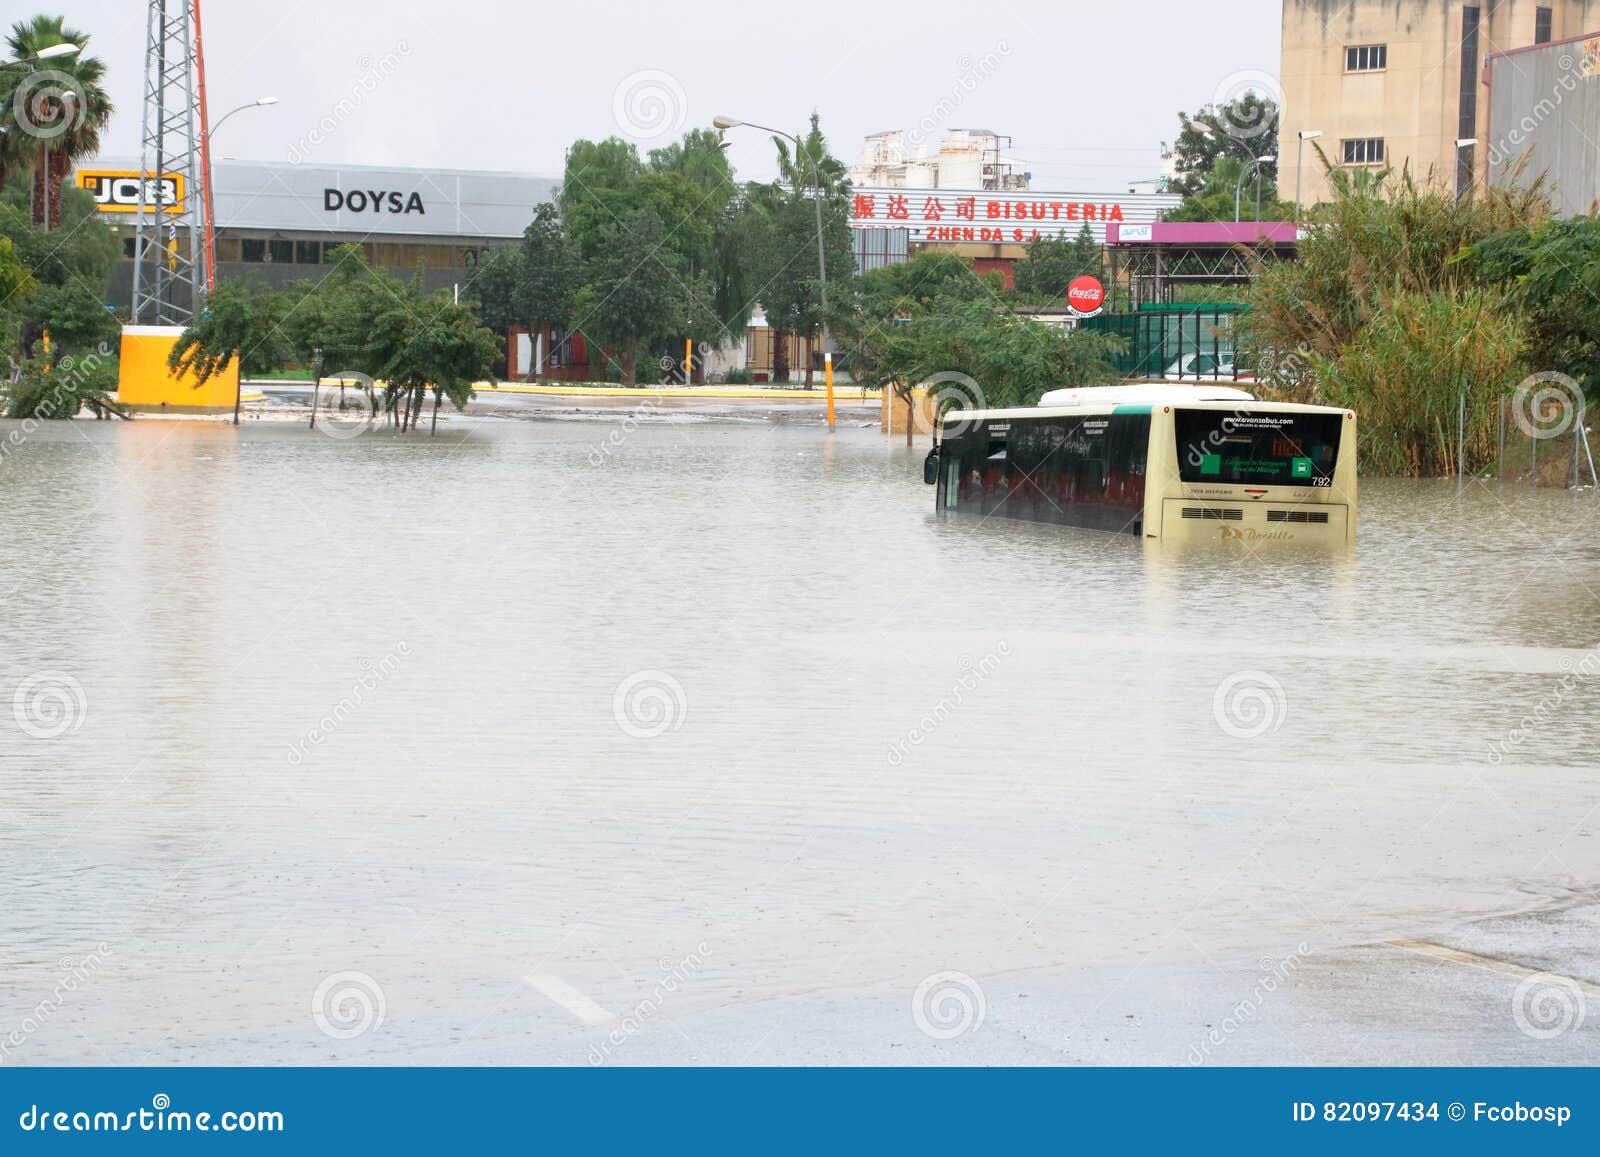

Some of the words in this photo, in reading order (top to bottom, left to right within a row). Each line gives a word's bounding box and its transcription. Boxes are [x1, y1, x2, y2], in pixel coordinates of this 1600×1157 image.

[94, 178, 176, 204] JCB
[324, 188, 425, 214] DOYSA
[987, 201, 1123, 221] BISUTERIA
[926, 226, 974, 241] ZHEN
[980, 227, 1003, 242] DA
[1311, 476, 1331, 487] 792
